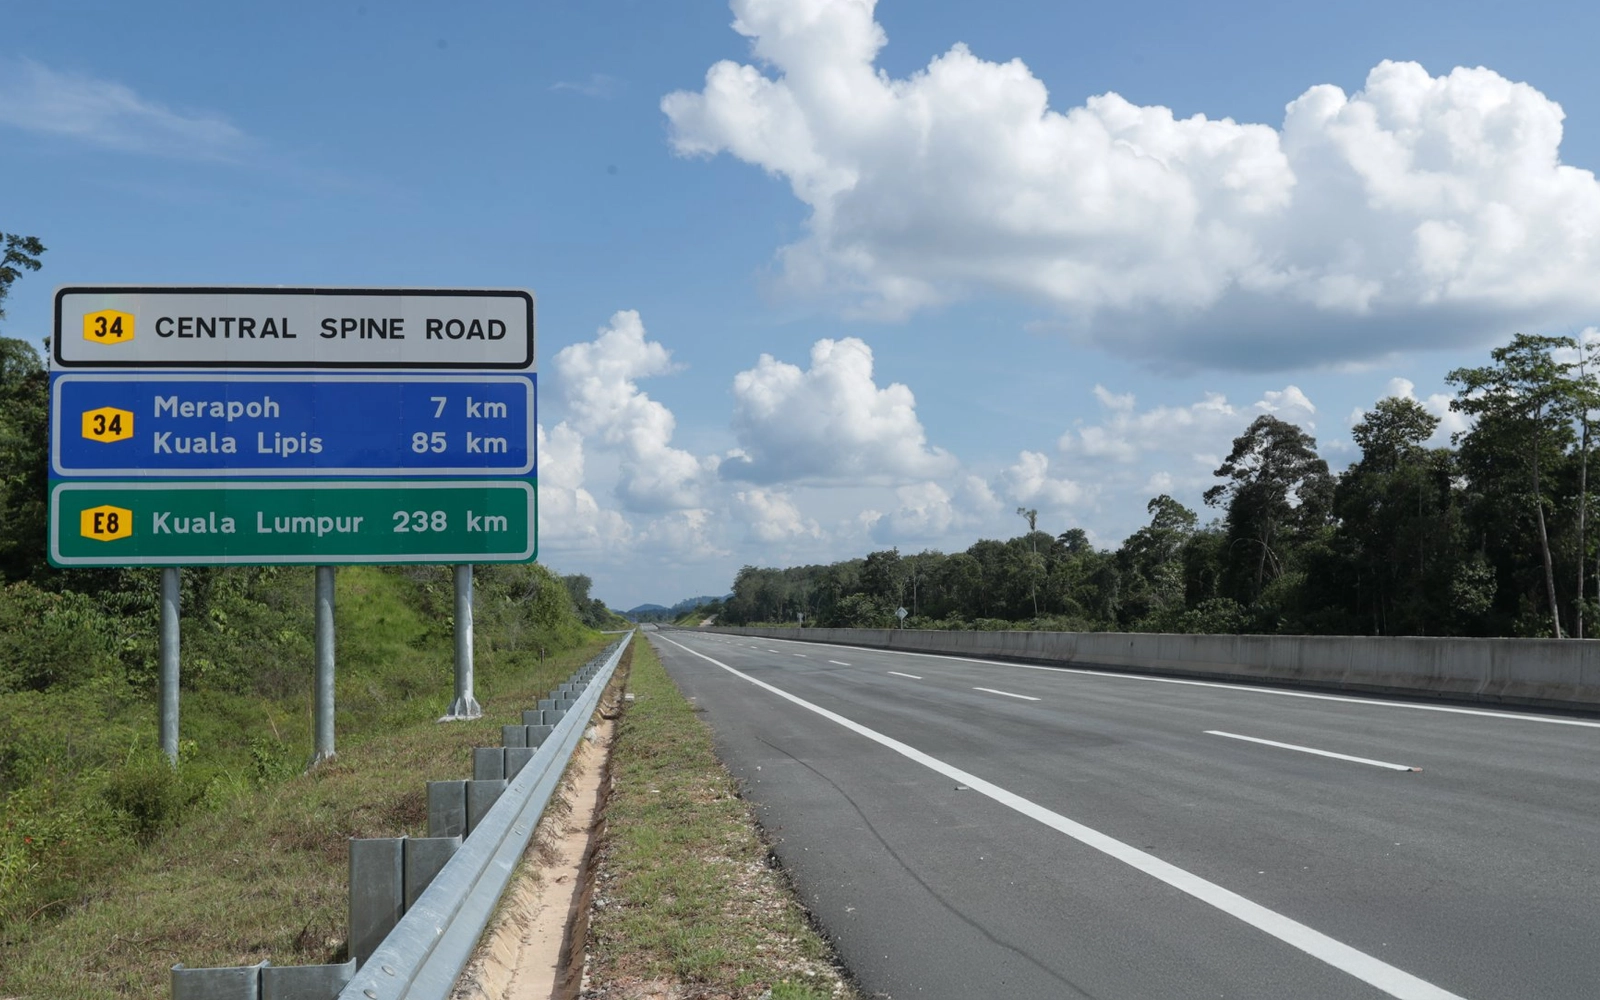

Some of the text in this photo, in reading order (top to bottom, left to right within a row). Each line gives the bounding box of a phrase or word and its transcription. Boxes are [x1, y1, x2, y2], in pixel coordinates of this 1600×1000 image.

[94, 317, 124, 336] 34
[155, 317, 506, 341] CENTRAL SPINE ROAD
[154, 396, 507, 422] Merapoh 7 km
[93, 414, 122, 435] 34
[154, 432, 507, 457] Kuala Lipis 85 km
[94, 512, 119, 533] E8
[153, 511, 508, 538] Kuala Lumpur 238 km
